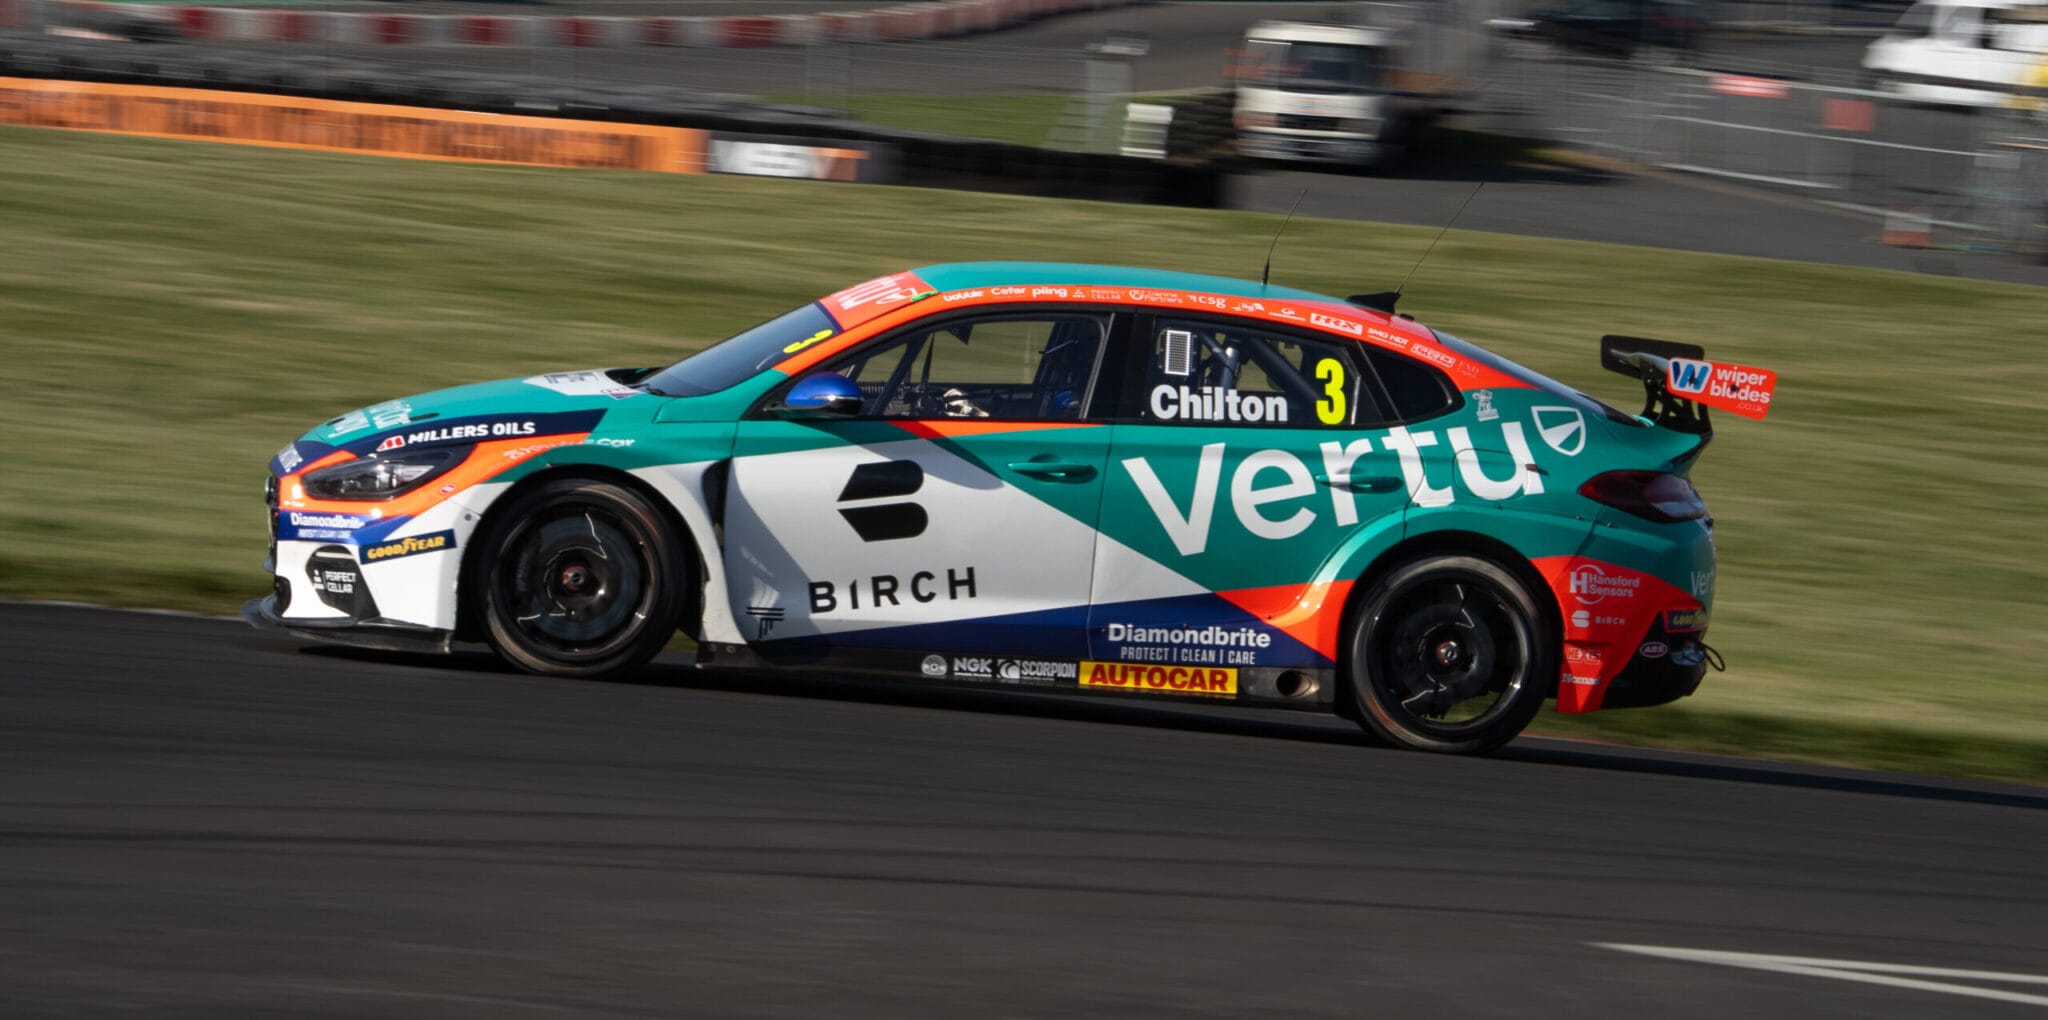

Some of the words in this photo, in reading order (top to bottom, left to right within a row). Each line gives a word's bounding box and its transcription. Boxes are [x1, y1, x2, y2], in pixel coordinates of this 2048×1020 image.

[1717, 366, 1767, 386] wiper
[1150, 384, 1288, 422] Chilton
[1315, 358, 1346, 425] 3
[408, 424, 489, 444] MILLERS
[493, 421, 536, 436] OILS
[367, 536, 446, 560] GOODYEAR
[808, 566, 977, 613] BIRCH
[1589, 574, 1640, 588] Hansford
[1589, 585, 1634, 597] Sensors
[1108, 623, 1271, 648] Diamondbrite
[953, 658, 993, 673] NGK
[1120, 647, 1169, 662] PROTECT
[1181, 648, 1215, 663] CLEAN
[1228, 650, 1256, 665] CARE
[1021, 661, 1077, 678] SCORPION
[1089, 665, 1229, 692] AUTOCAR
